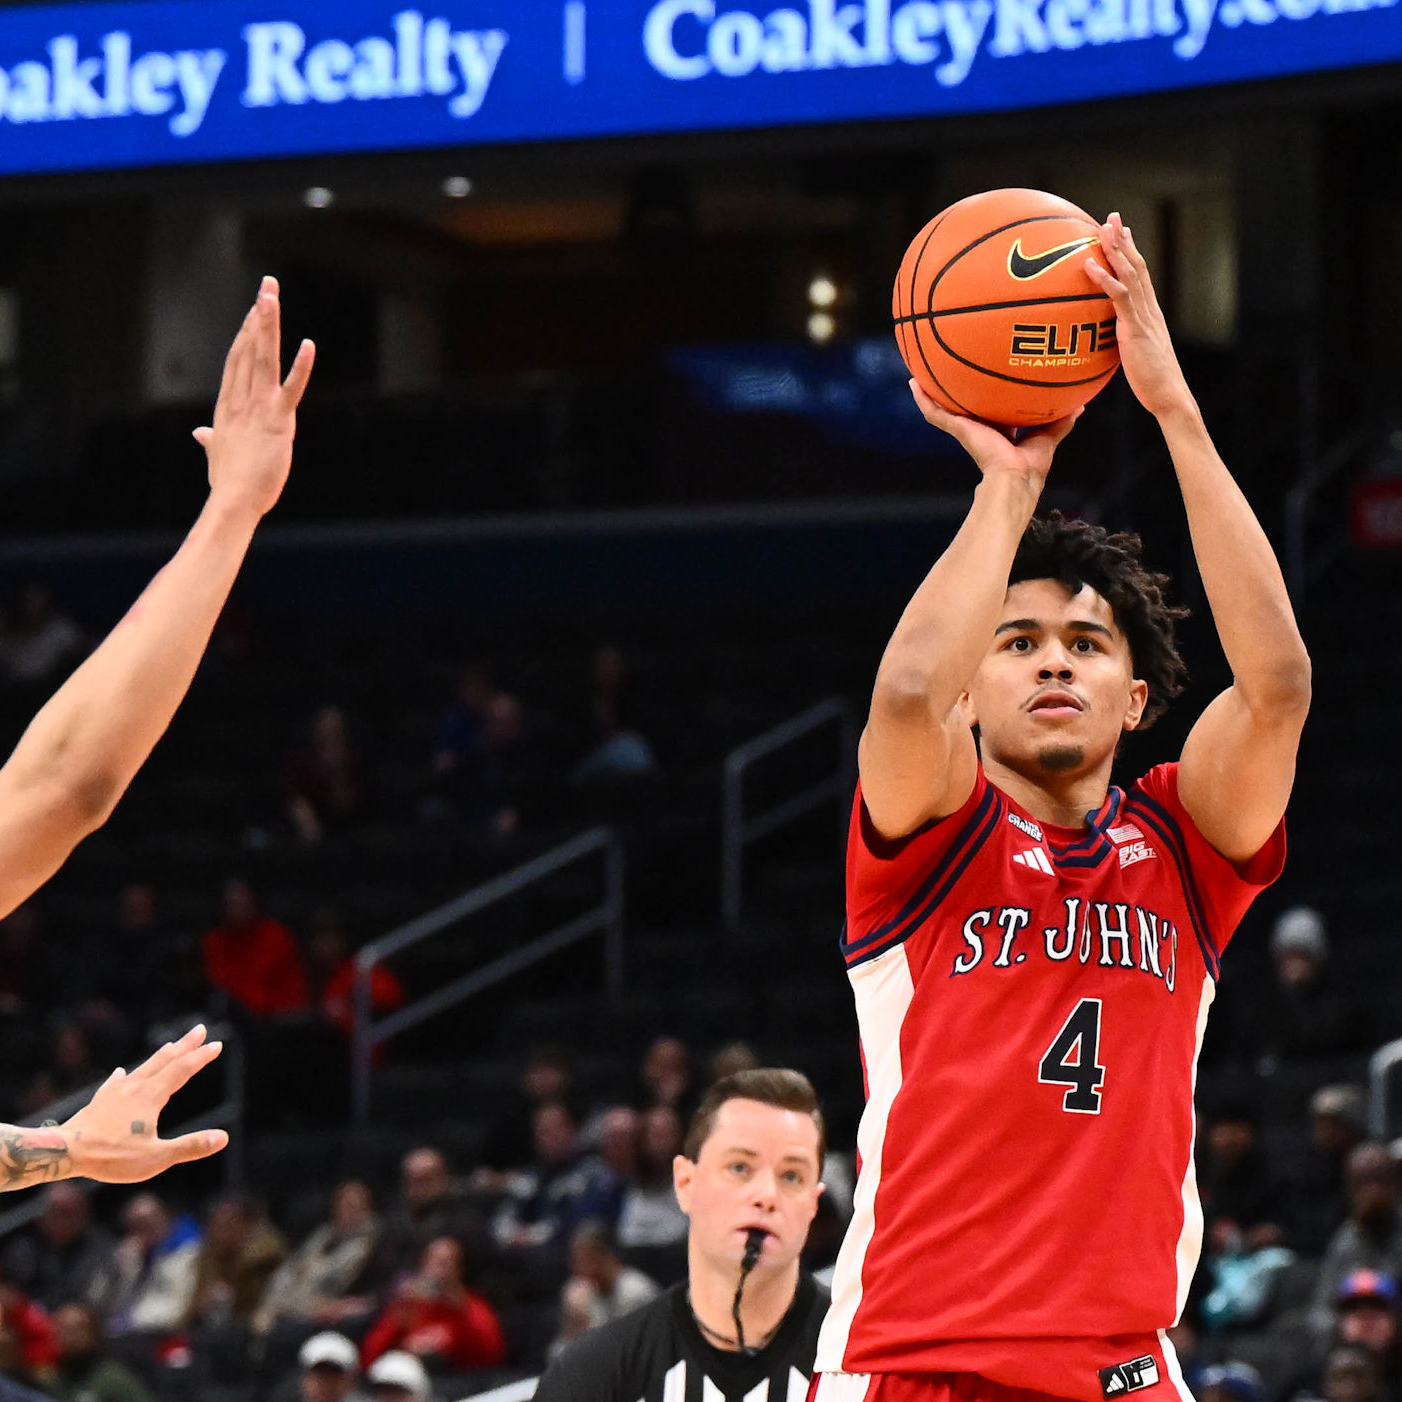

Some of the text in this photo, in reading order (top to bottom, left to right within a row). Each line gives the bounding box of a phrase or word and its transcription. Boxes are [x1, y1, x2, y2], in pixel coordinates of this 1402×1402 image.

[242, 11, 508, 118] Realty
[1010, 319, 1118, 357] ELITE
[1118, 841, 1146, 858] BIG
[949, 905, 1032, 978] ST.
[1038, 998, 1106, 1115] 4
